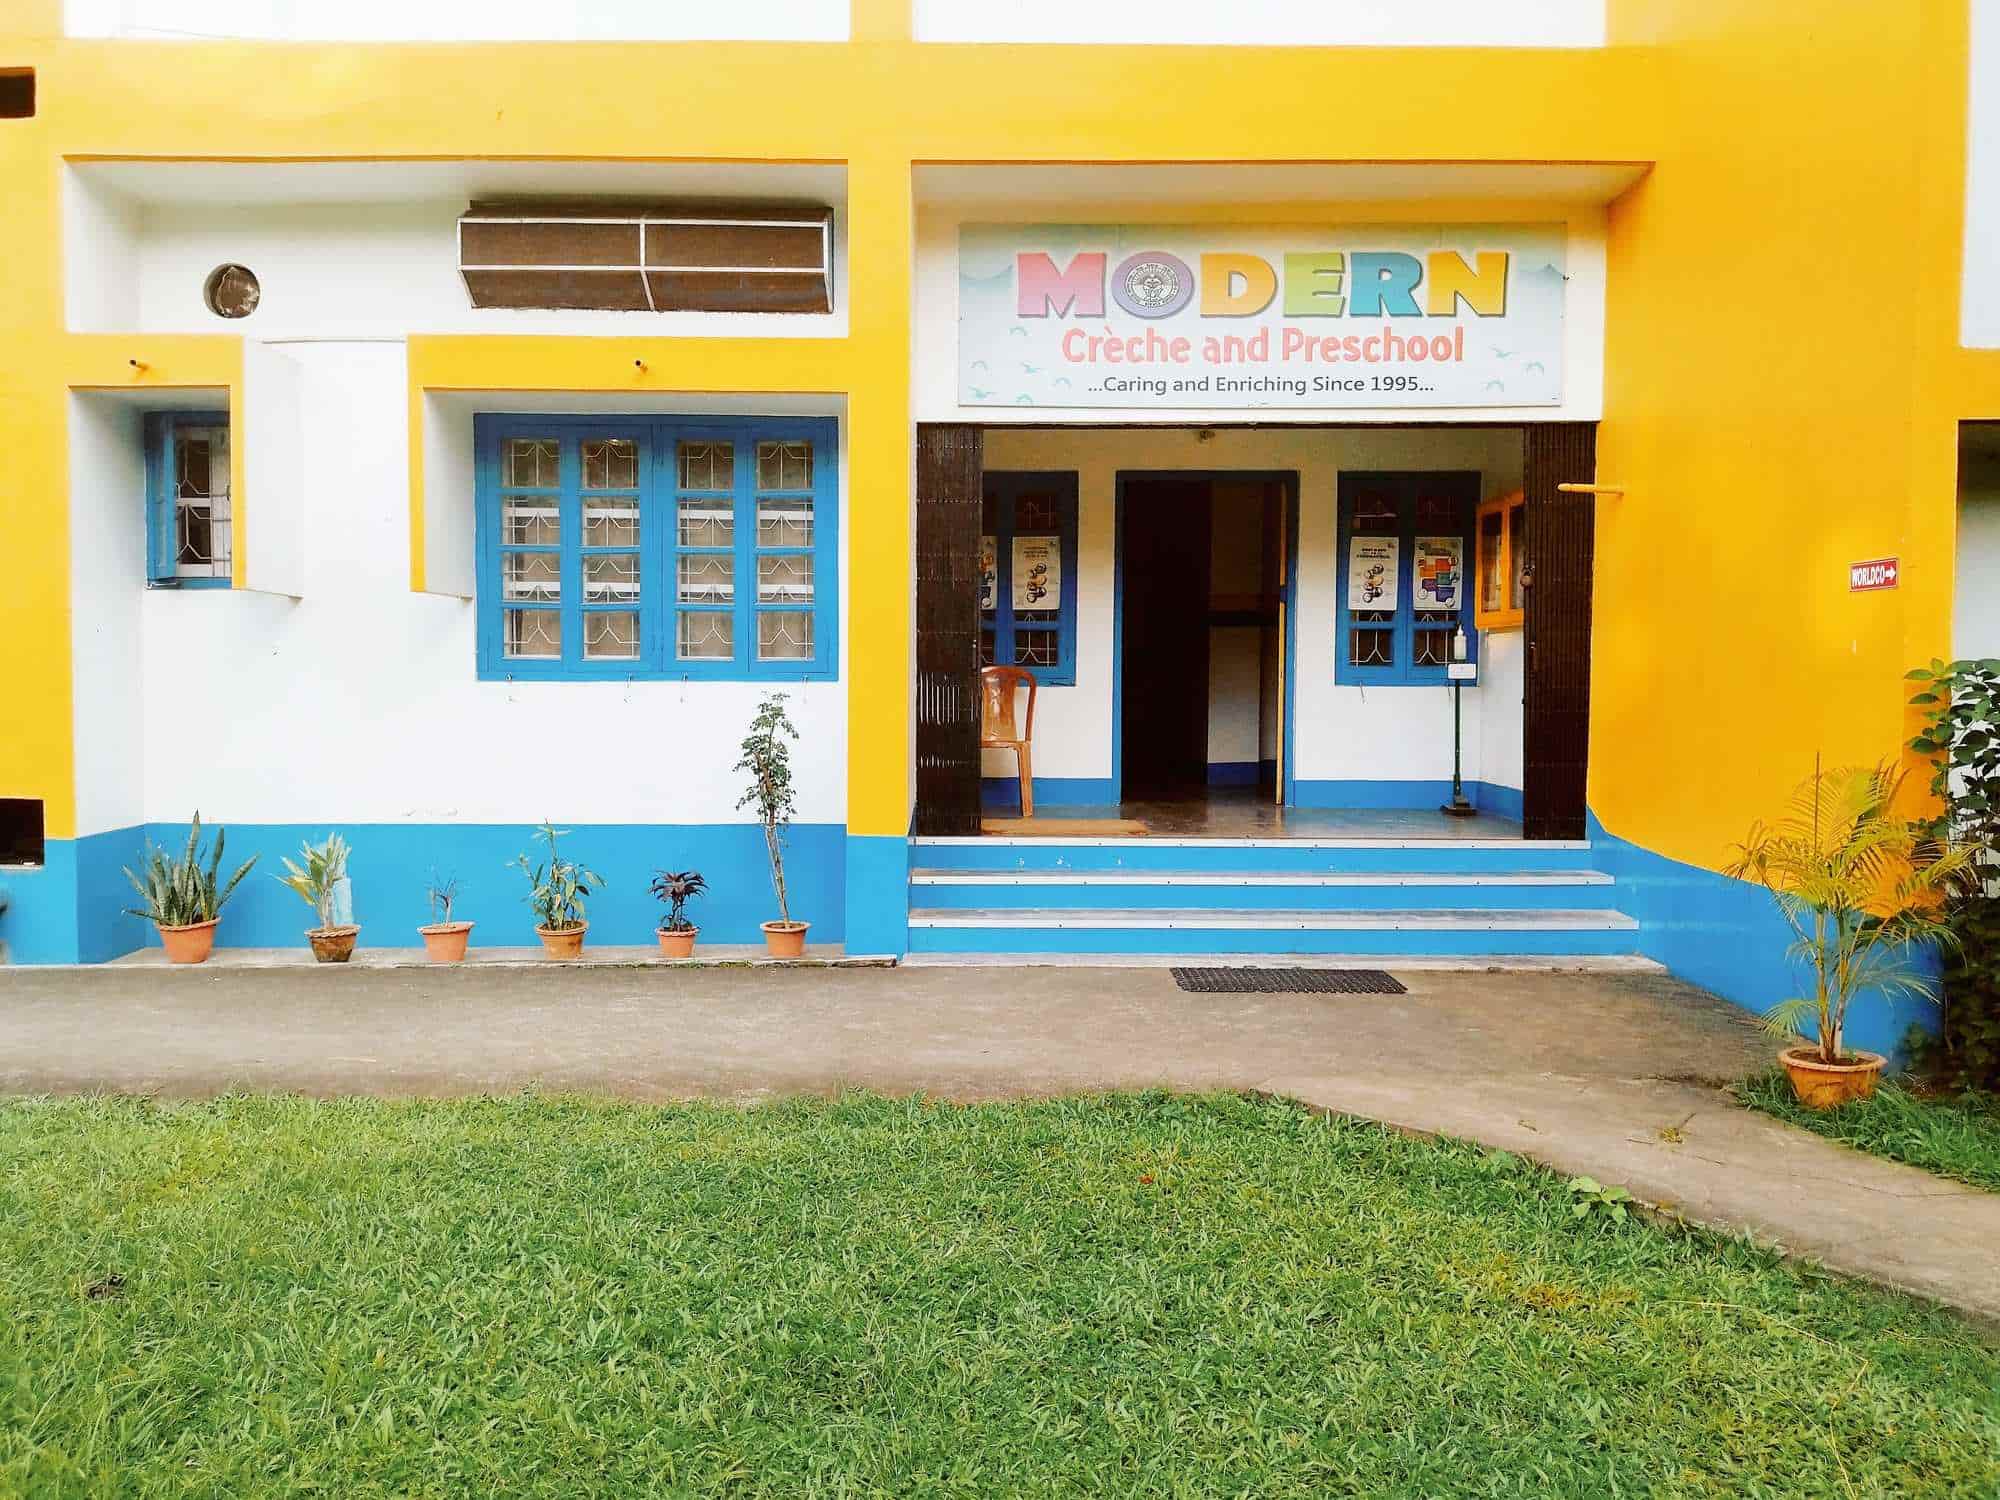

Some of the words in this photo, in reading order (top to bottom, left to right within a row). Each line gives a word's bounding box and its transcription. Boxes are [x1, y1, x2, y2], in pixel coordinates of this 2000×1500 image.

[1018, 252, 1508, 319] MODERN
[1063, 324, 1190, 364] Crèche
[1203, 326, 1270, 363] and
[1282, 326, 1464, 363] Preschool
[1174, 376, 1208, 392] and
[1217, 375, 1306, 396] Enriching
[1313, 375, 1365, 391] Since
